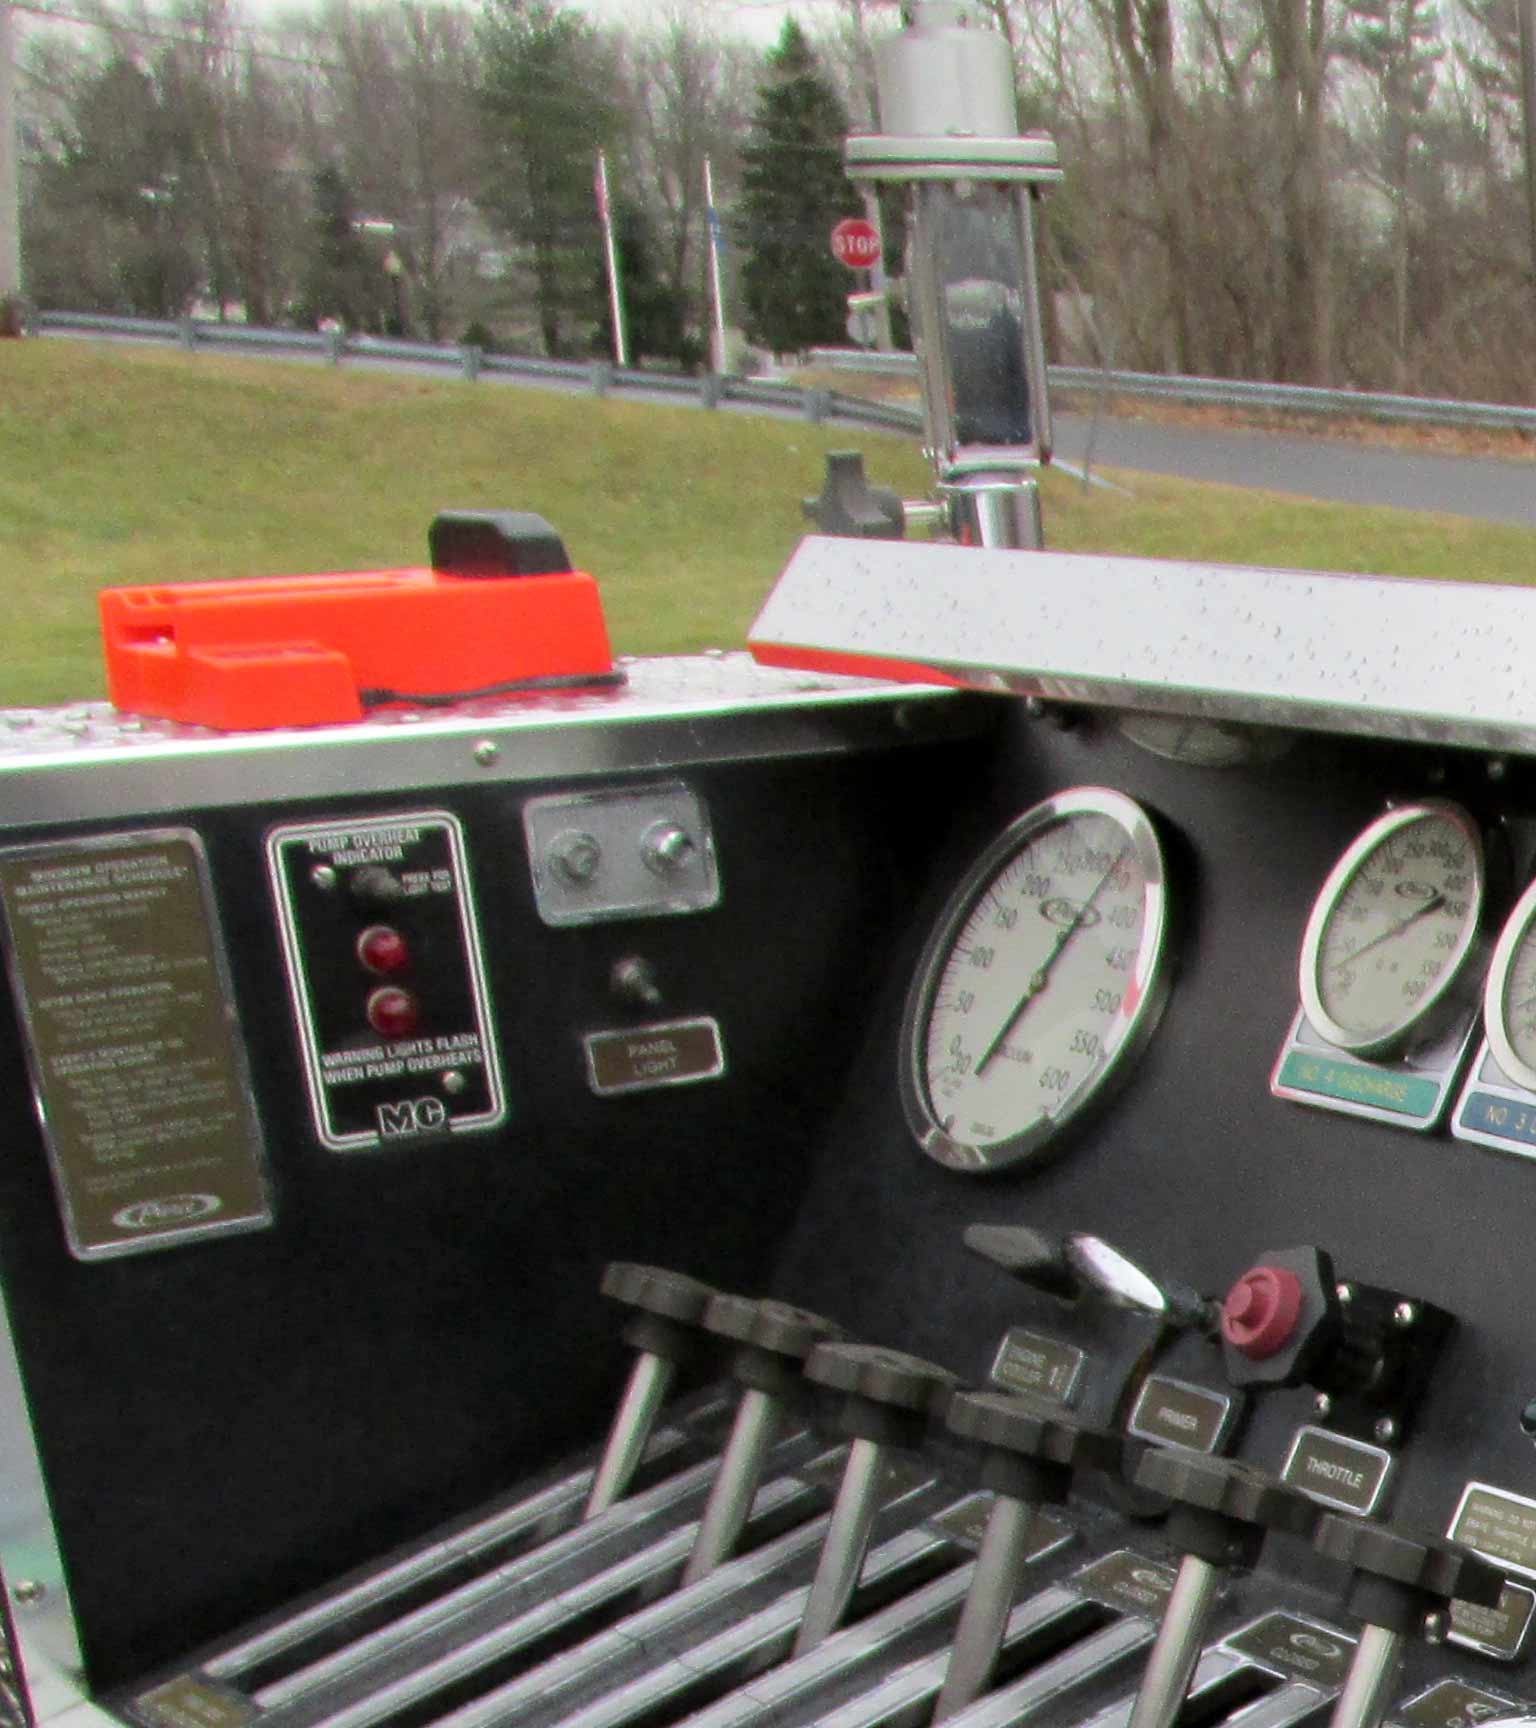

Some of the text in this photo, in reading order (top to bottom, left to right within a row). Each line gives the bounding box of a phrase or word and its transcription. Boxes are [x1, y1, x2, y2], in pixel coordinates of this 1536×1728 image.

[309, 829, 421, 853] PUMP OVERHEAT
[333, 846, 404, 865] INDICATOR
[322, 1032, 479, 1067] WARNING LIGHTS FLASH
[629, 1040, 677, 1057] PANEL
[323, 1051, 481, 1084] WHEN PUMP OVERHEATS
[634, 1056, 677, 1076] LIGHT
[1515, 1113, 1527, 1131] 3
[1305, 1455, 1365, 1490] THROTTLE
